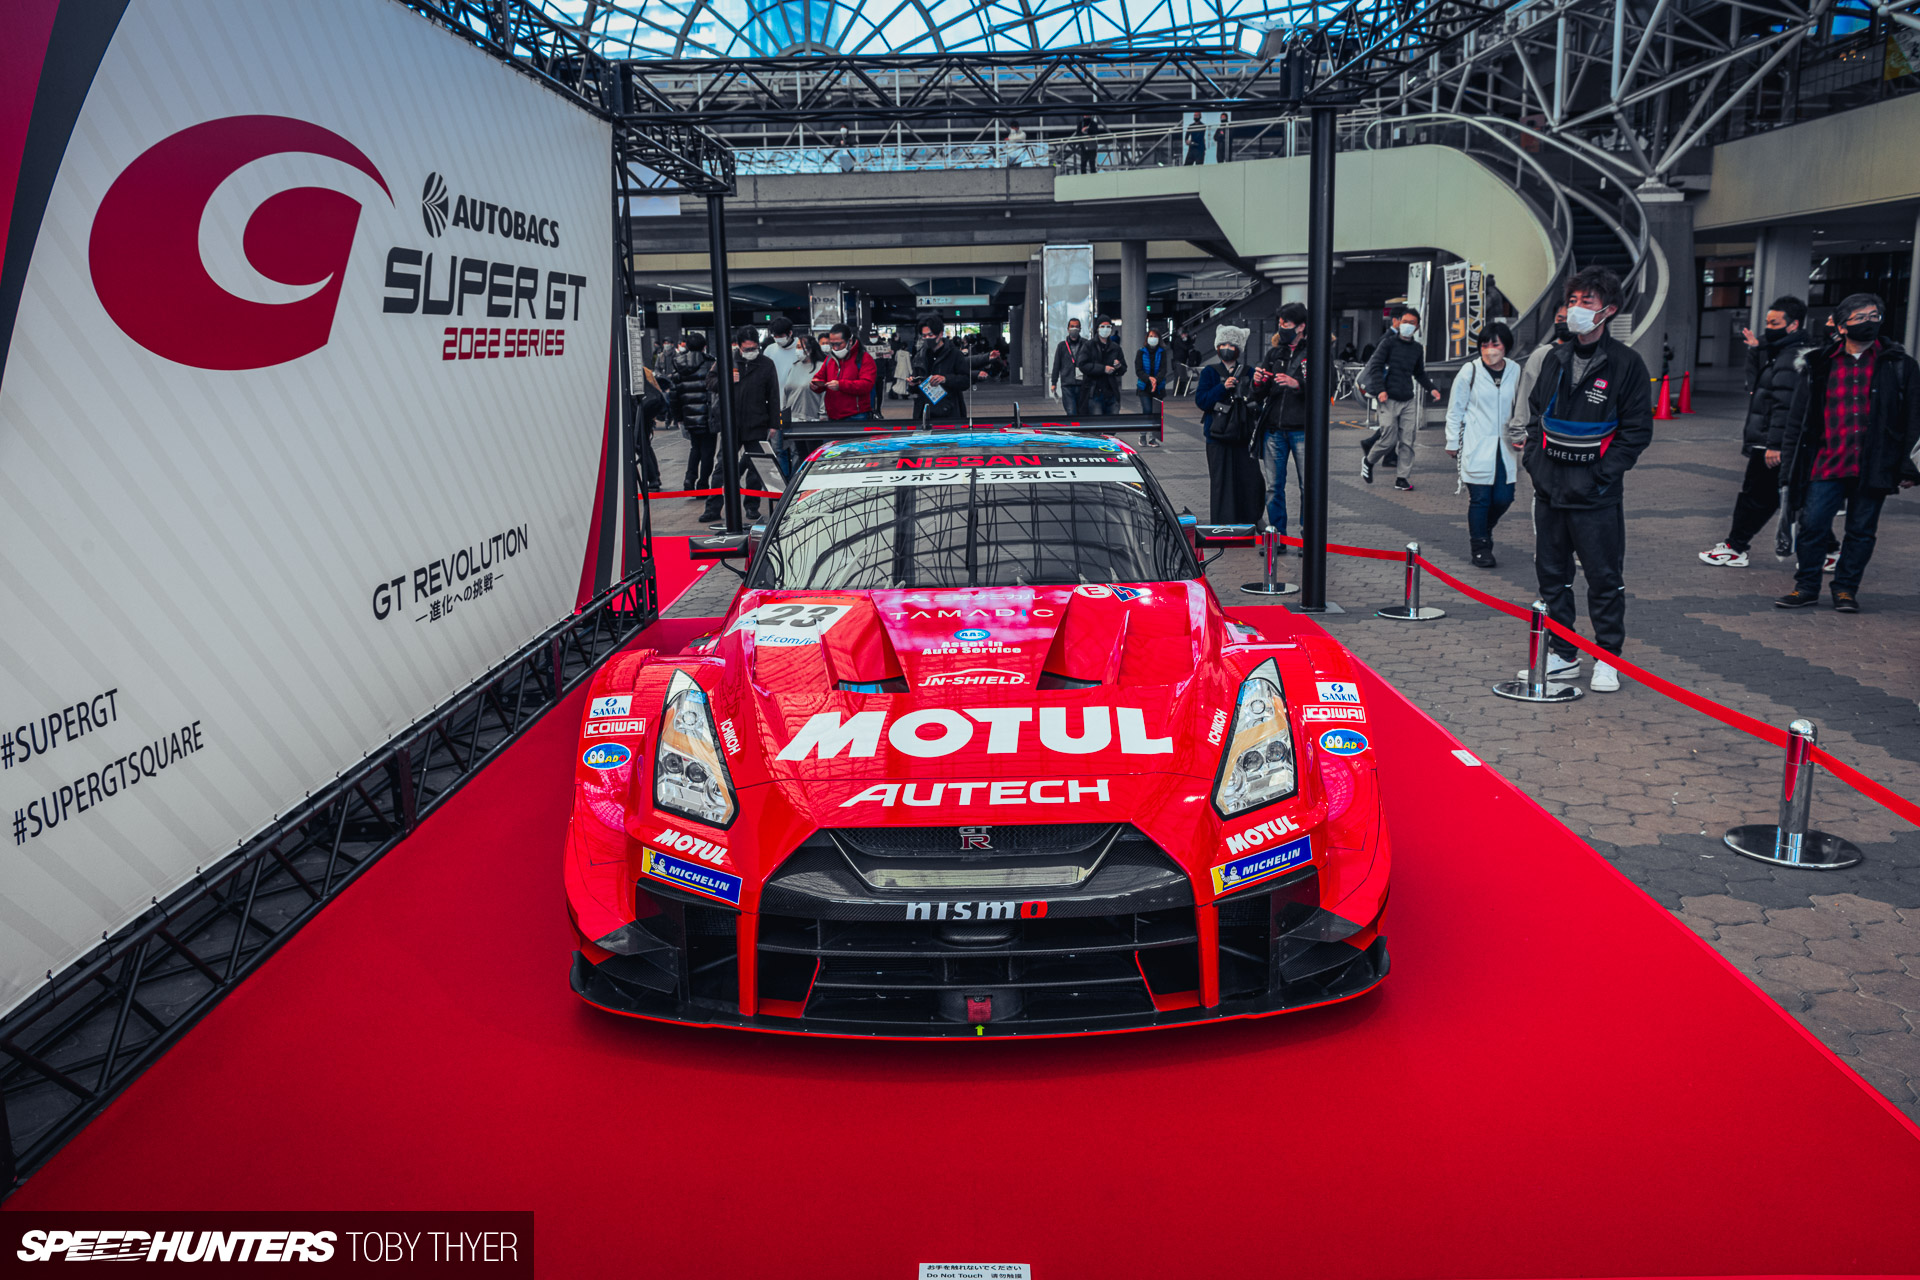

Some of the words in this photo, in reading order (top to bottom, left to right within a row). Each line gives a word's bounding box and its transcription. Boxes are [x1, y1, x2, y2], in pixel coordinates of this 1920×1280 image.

[452, 195, 559, 248] AUTOBACS
[383, 247, 538, 319] SUPER
[545, 271, 587, 321] GT
[442, 327, 501, 360] 2022
[504, 328, 565, 358] SERIES
[818, 461, 879, 471] nismo
[896, 455, 1042, 470] NISSAN
[1058, 456, 1119, 464] nismo
[1547, 448, 1595, 462] SHELTER
[373, 575, 406, 621] GT
[414, 523, 528, 603] REVOLUTION
[758, 605, 838, 628] 23
[889, 608, 1054, 620] TAMADIC
[918, 676, 1025, 687] JN-SHIELD
[592, 706, 628, 717] SANKIN
[1321, 693, 1358, 702] SANKIN
[1, 688, 118, 770] #SUPERGT
[720, 718, 741, 756] ICHIKOH
[775, 706, 1174, 760] MOTUL
[1207, 708, 1228, 746] ICHIKOH
[13, 720, 204, 846] #SUPERGTSQUARE
[838, 779, 1110, 808] AUTECH
[653, 828, 728, 865] MOTUL
[1226, 815, 1300, 855] MOTUL
[1242, 847, 1301, 876] MICHELIN
[668, 865, 730, 892] MICHELIN
[906, 901, 1049, 920] nismo
